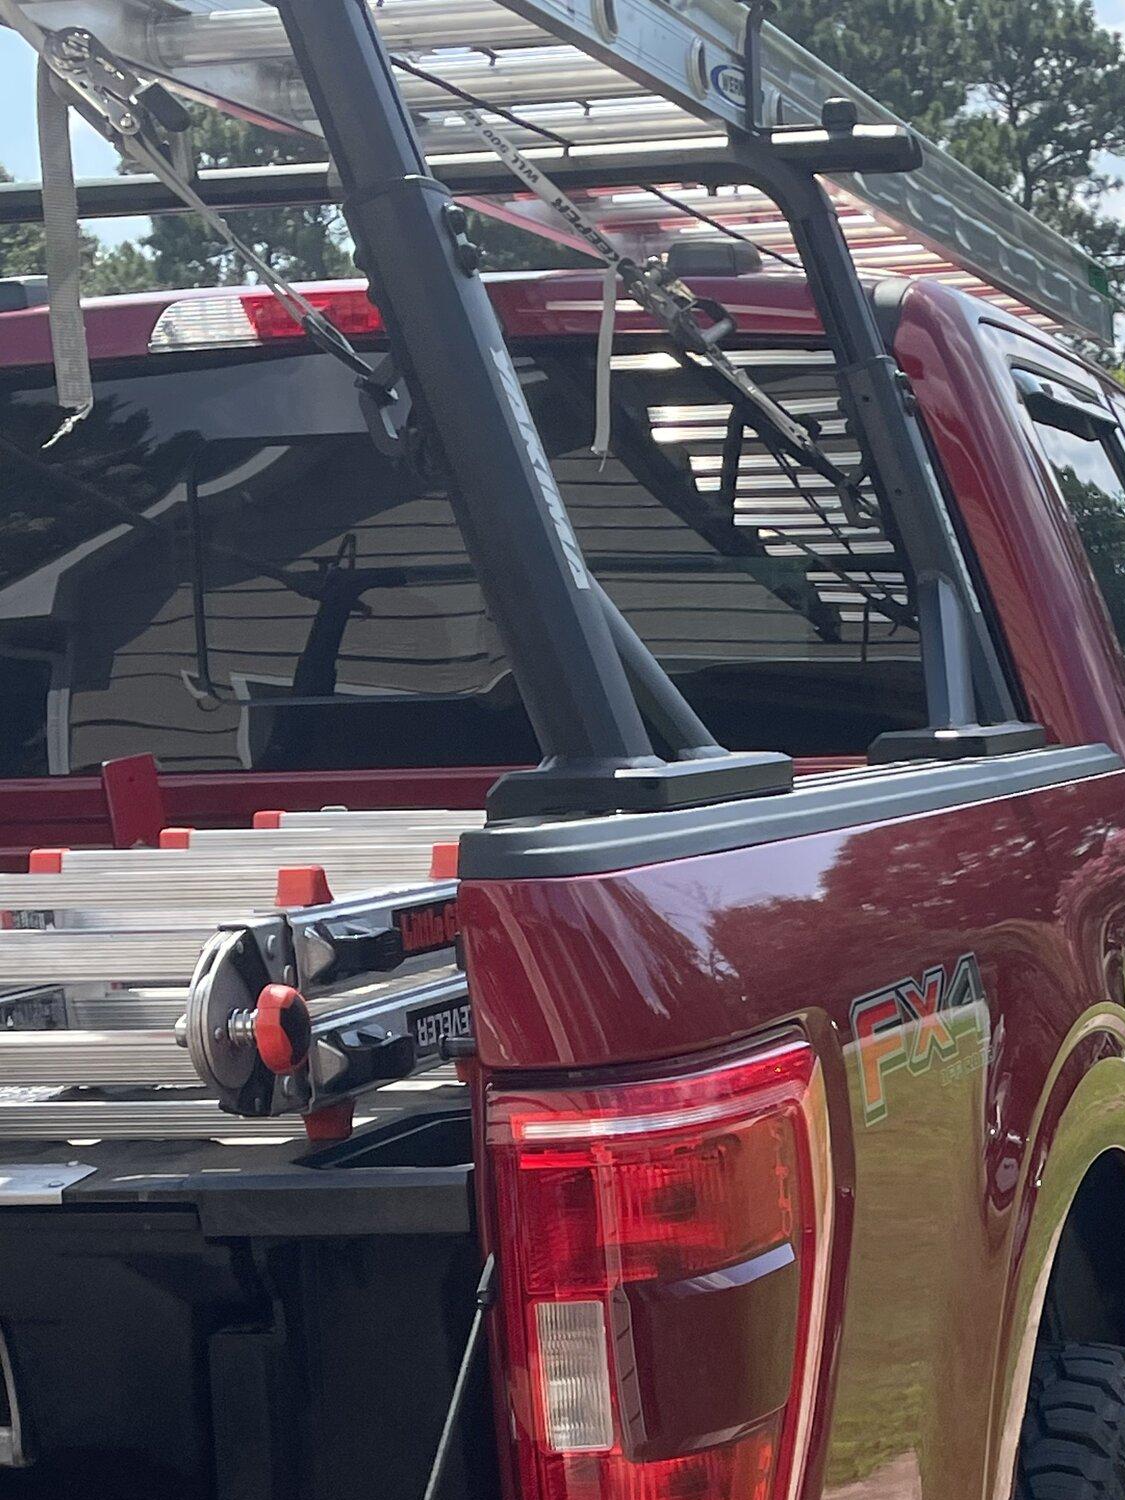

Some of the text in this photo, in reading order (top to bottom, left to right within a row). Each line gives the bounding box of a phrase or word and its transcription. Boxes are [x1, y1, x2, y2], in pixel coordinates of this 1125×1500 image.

[511, 155, 539, 184] WLL
[552, 197, 620, 263] KEEPER
[489, 346, 591, 590] YAKIMA
[849, 951, 991, 1128] FX4
